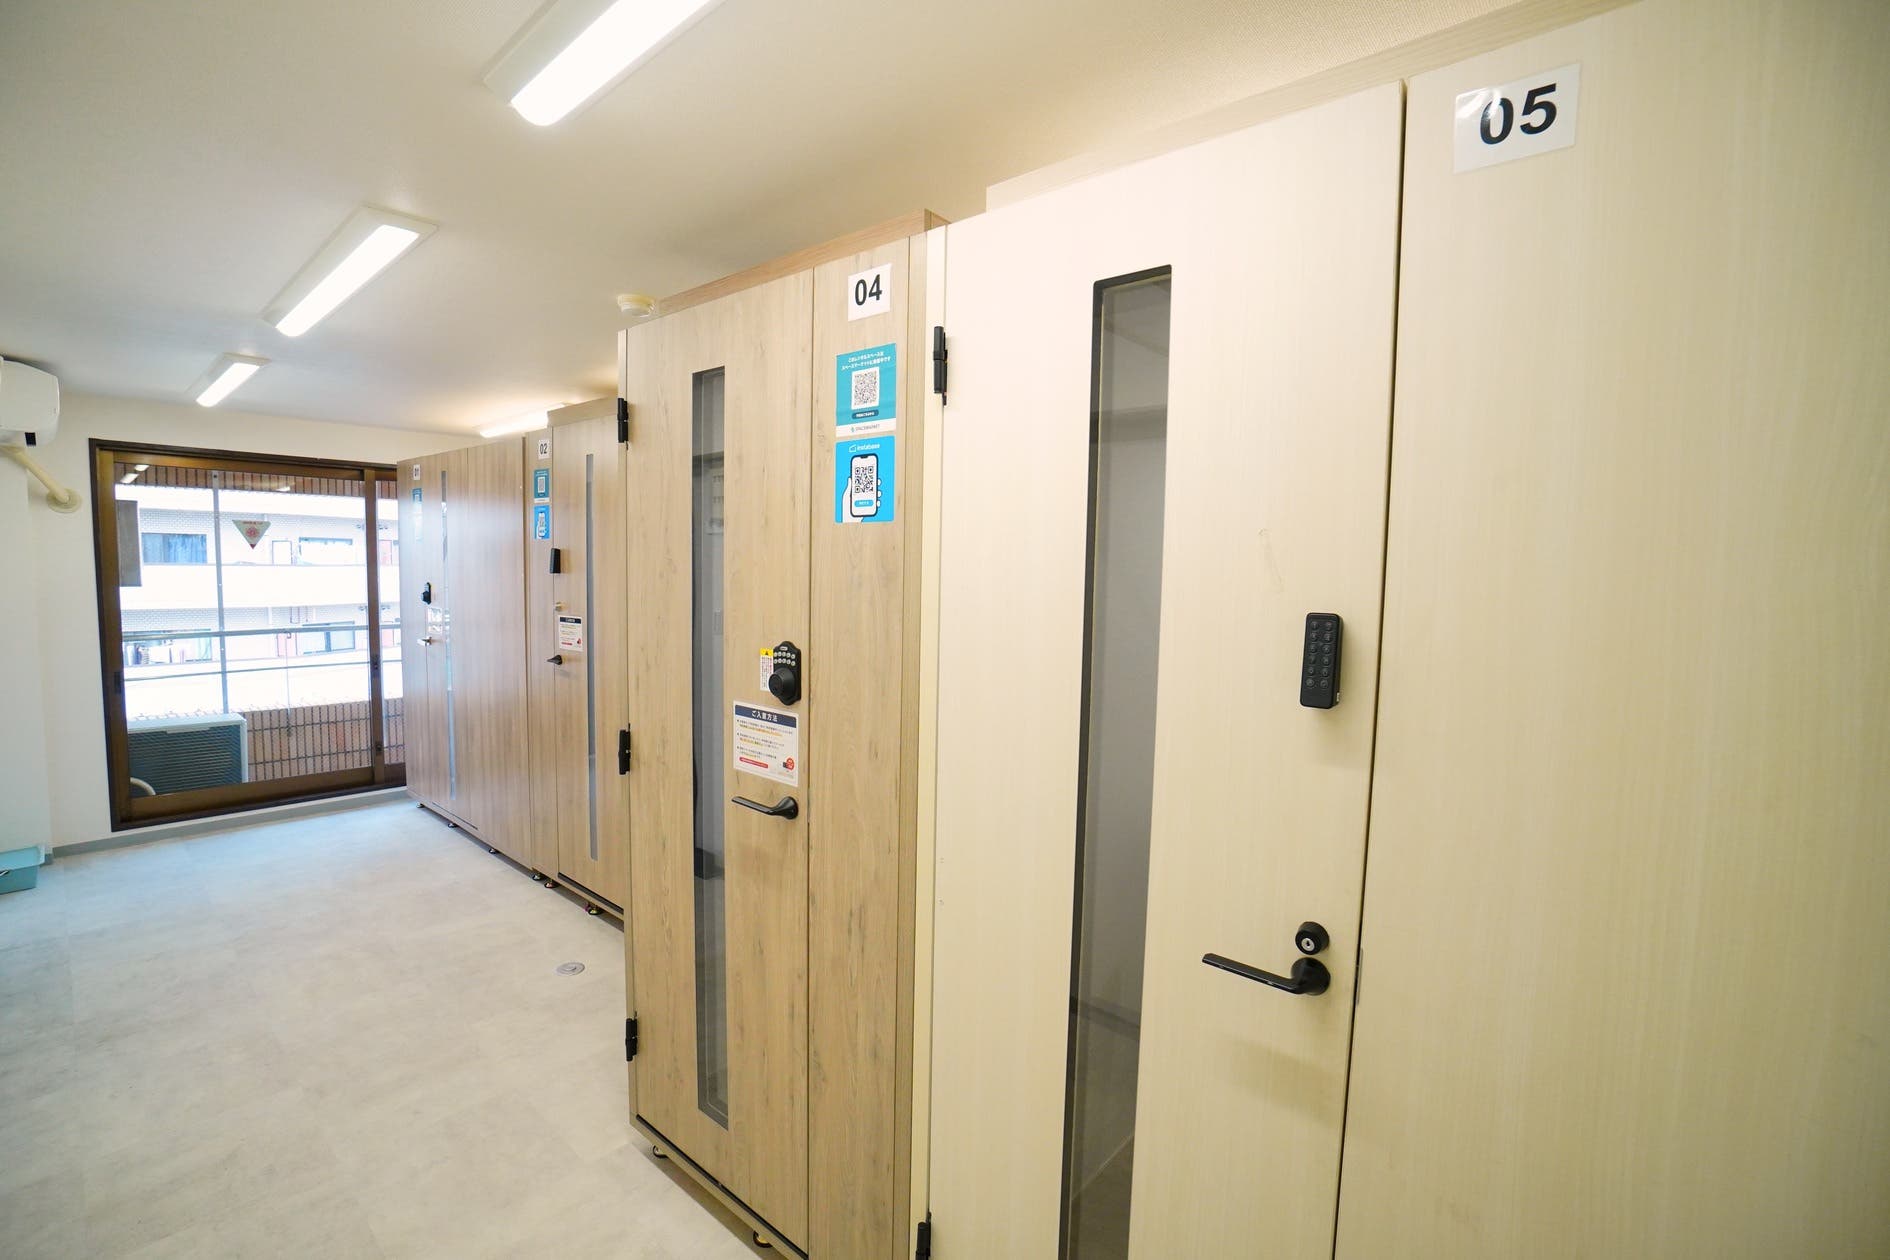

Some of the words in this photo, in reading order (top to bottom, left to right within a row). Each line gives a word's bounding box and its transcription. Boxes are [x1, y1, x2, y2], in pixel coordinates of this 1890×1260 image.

[1480, 83, 1557, 145] 05
[855, 274, 883, 306] 04
[540, 443, 548, 455] 02
